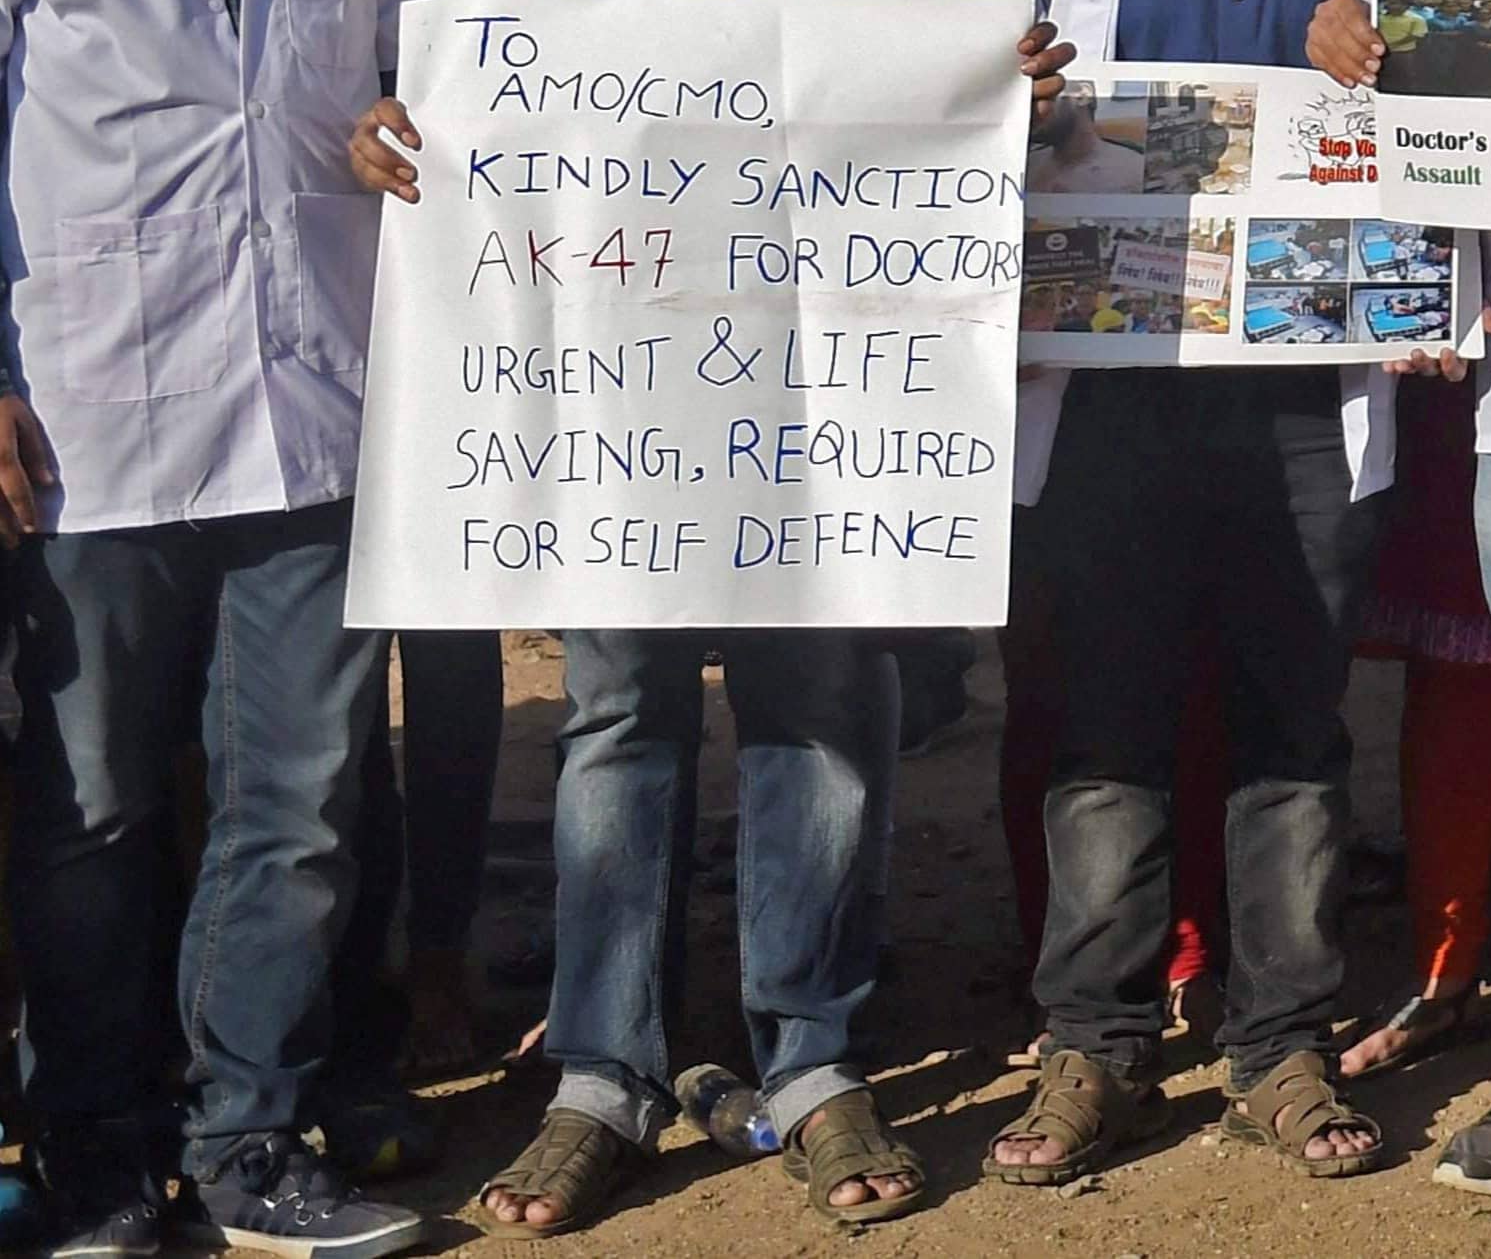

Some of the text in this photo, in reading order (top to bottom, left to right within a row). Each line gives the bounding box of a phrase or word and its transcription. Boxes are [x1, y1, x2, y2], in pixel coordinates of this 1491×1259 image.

[1319, 137, 1352, 161] Stop
[1395, 127, 1487, 152] Doctor's
[466, 149, 1026, 211] KINDLY SANCTION
[1309, 163, 1364, 185] Against
[1403, 161, 1482, 186] Assault
[469, 229, 1021, 296] AK-47 FOR DOCTORS
[462, 315, 943, 395] URGENT & LIFE
[446, 417, 996, 490] SAVING, REQUIRED
[463, 510, 980, 573] FOR SELF DEFENCE
